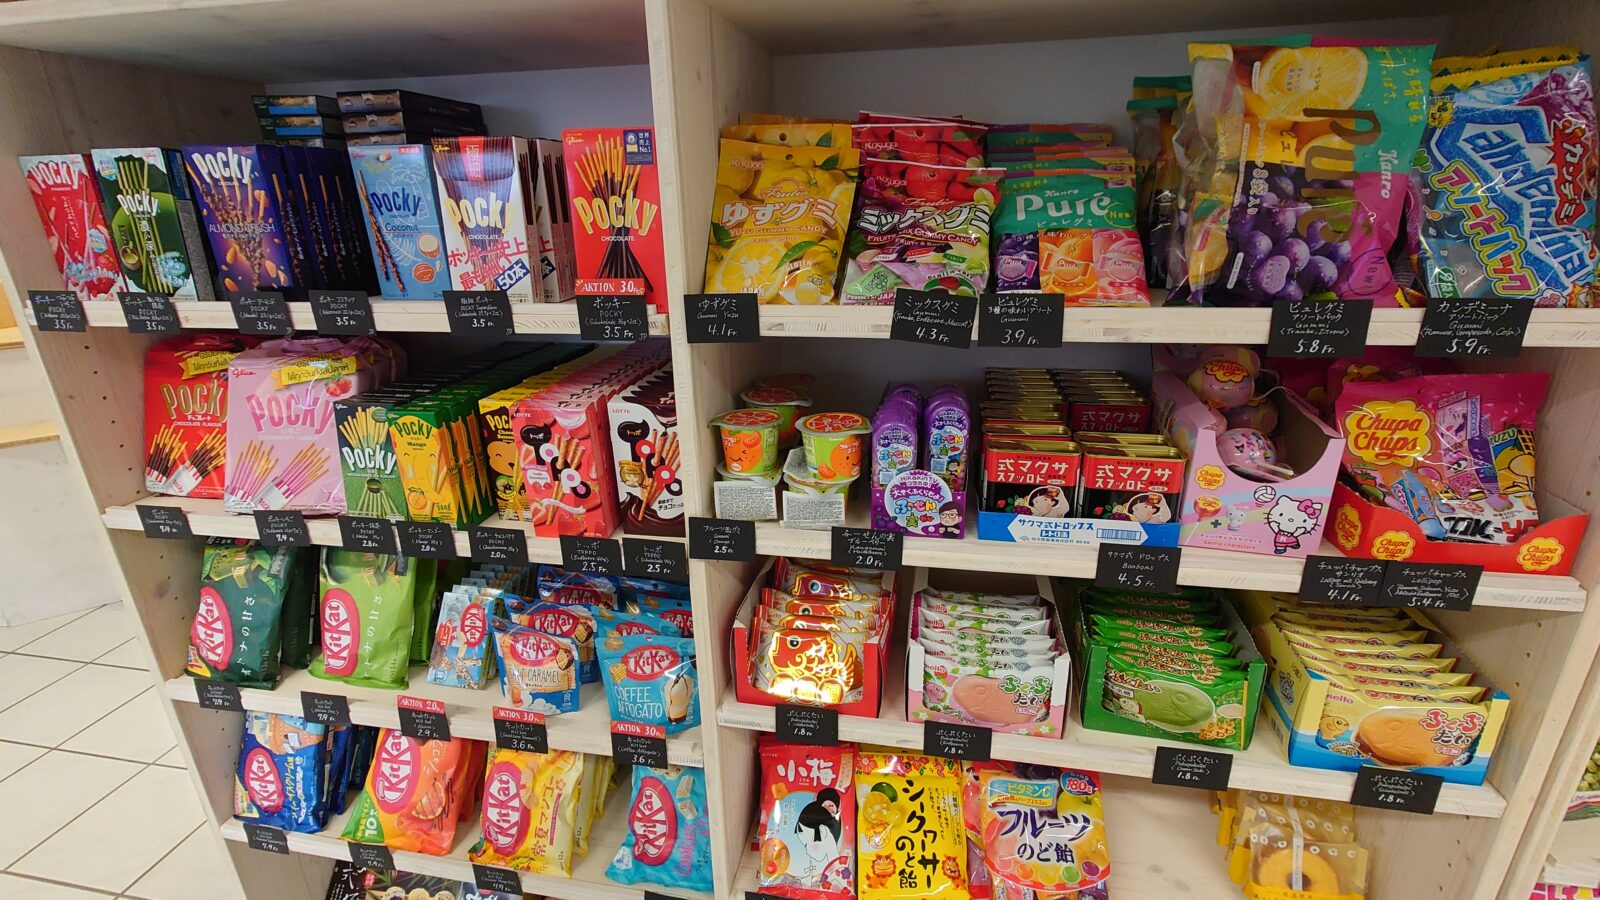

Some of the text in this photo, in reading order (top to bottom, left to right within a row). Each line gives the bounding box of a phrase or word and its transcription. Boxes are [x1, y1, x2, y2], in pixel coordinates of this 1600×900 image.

[720, 198, 840, 230] ゆずグミ
[858, 205, 992, 235] ミックスグミ
[582, 280, 634, 293] AKTION 3.0
[593, 297, 631, 309] ポッキー
[698, 298, 737, 312] ゆずグミ
[905, 295, 960, 314] ミックスグミ
[998, 296, 1038, 308] ピュレグミ
[1289, 302, 1343, 314] ピュレグミ
[1437, 302, 1513, 315] カンデミーナ
[599, 310, 623, 318] POCKY
[257, 321, 269, 330] 3.5
[336, 317, 349, 326] 3.5
[472, 318, 485, 328] 3.5
[603, 326, 620, 339] 3.5
[916, 327, 937, 341] 4.3
[1001, 329, 1025, 344] 3.9
[1294, 339, 1320, 354] 5.8
[1445, 338, 1475, 354] 5.9
[1355, 413, 1424, 440] Chupa
[1353, 432, 1420, 459] Chups
[1017, 519, 1094, 532] サクマ式ドロップス
[1379, 536, 1411, 549] Chupa
[714, 545, 727, 554] 2.5
[1376, 545, 1409, 559] Chups
[1525, 544, 1559, 557] Chupa
[855, 556, 873, 566] 2.0
[1522, 552, 1557, 566] Chups
[582, 562, 595, 571] 2.5
[646, 564, 661, 573] 2.5
[1118, 573, 1144, 587] 4.5
[1328, 589, 1350, 601] 4.1
[1407, 597, 1434, 608] 5.4
[527, 669, 561, 683] CARAMEL
[614, 686, 651, 702] COFFEE
[400, 698, 423, 708] AKTION
[498, 710, 534, 721] AKTION 3.0
[417, 729, 430, 737] 2.9
[617, 724, 656, 734] AKTION 3.0
[794, 728, 806, 736] 1.8
[511, 739, 525, 749] 3.6
[632, 754, 645, 763] 3.6
[776, 759, 837, 787] 小梅
[1177, 770, 1191, 780] 1.8
[1008, 783, 1051, 797] ビタミンC
[1377, 793, 1394, 804] 1.8
[997, 809, 1091, 842] フルーツ
[1017, 843, 1074, 864] のど飴
